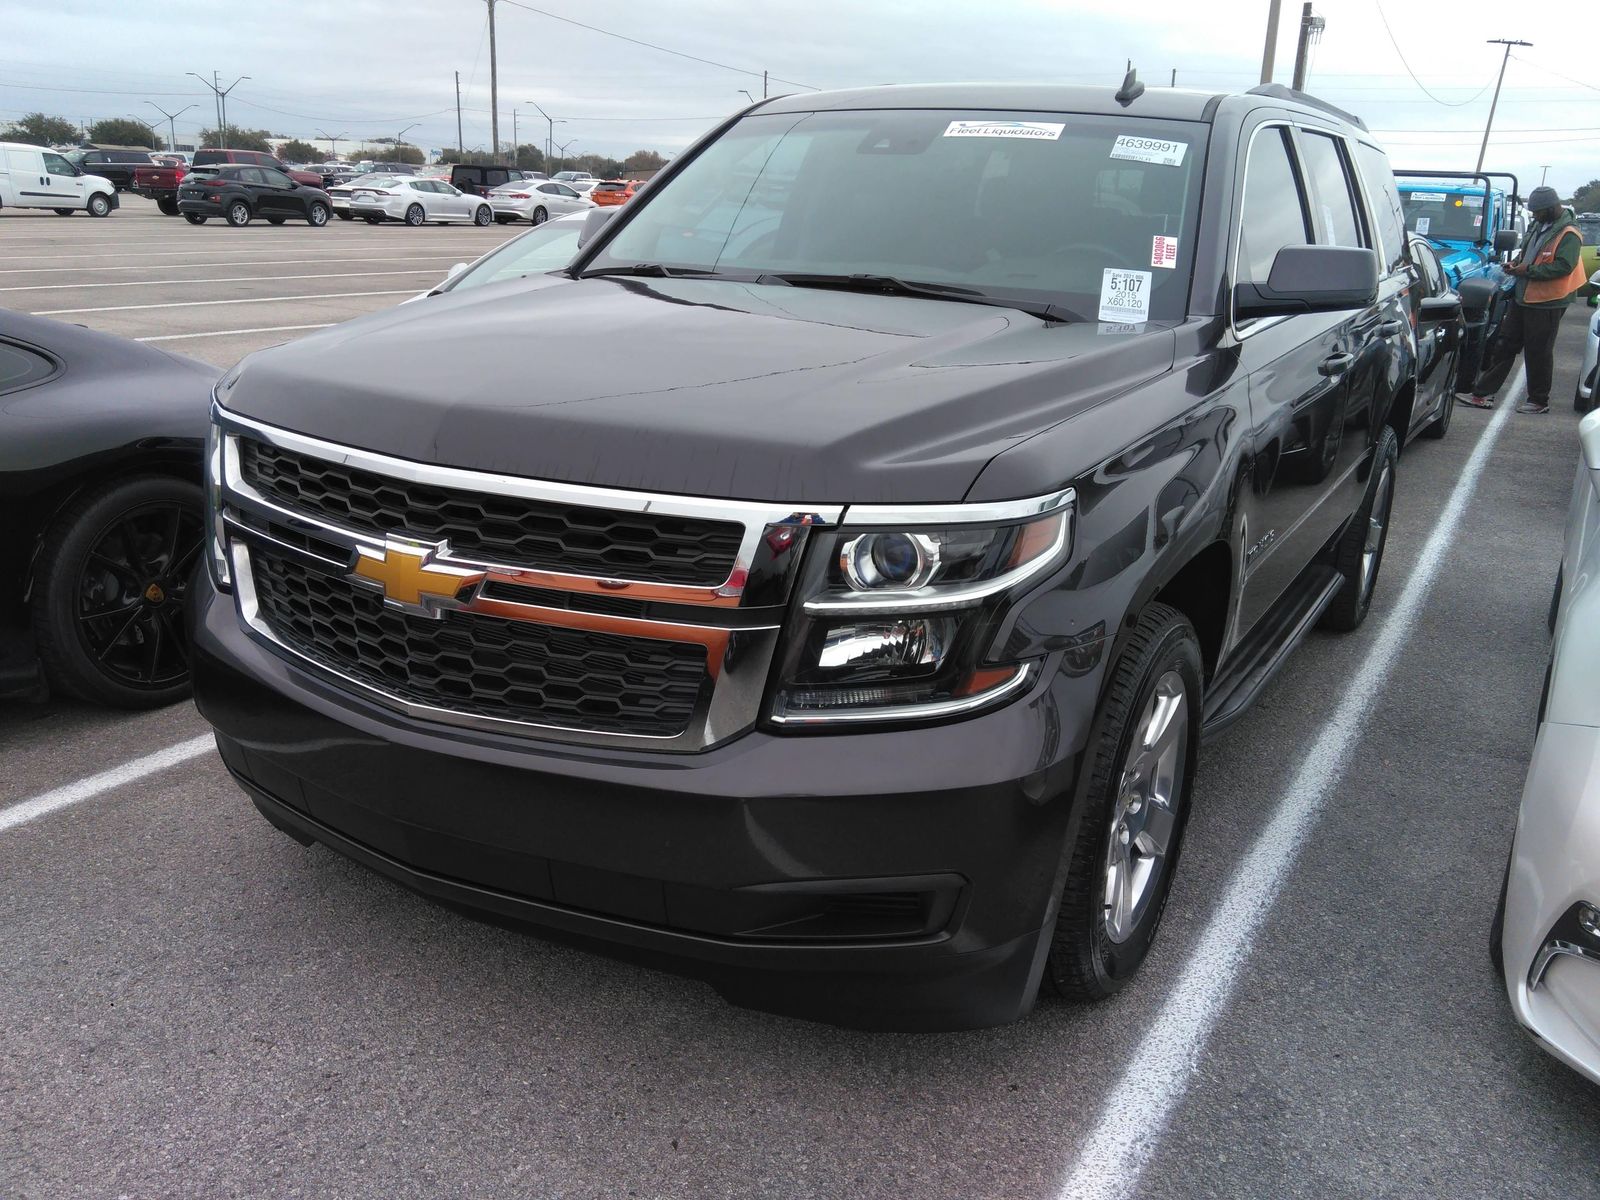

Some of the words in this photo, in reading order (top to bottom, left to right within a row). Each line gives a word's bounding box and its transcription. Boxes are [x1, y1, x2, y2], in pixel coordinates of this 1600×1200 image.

[983, 127, 1057, 137] Liquidators
[1116, 138, 1178, 153] 4639991
[1165, 243, 1176, 260] FLEET
[1111, 278, 1142, 292] 5:107
[1115, 291, 1137, 299] 2015
